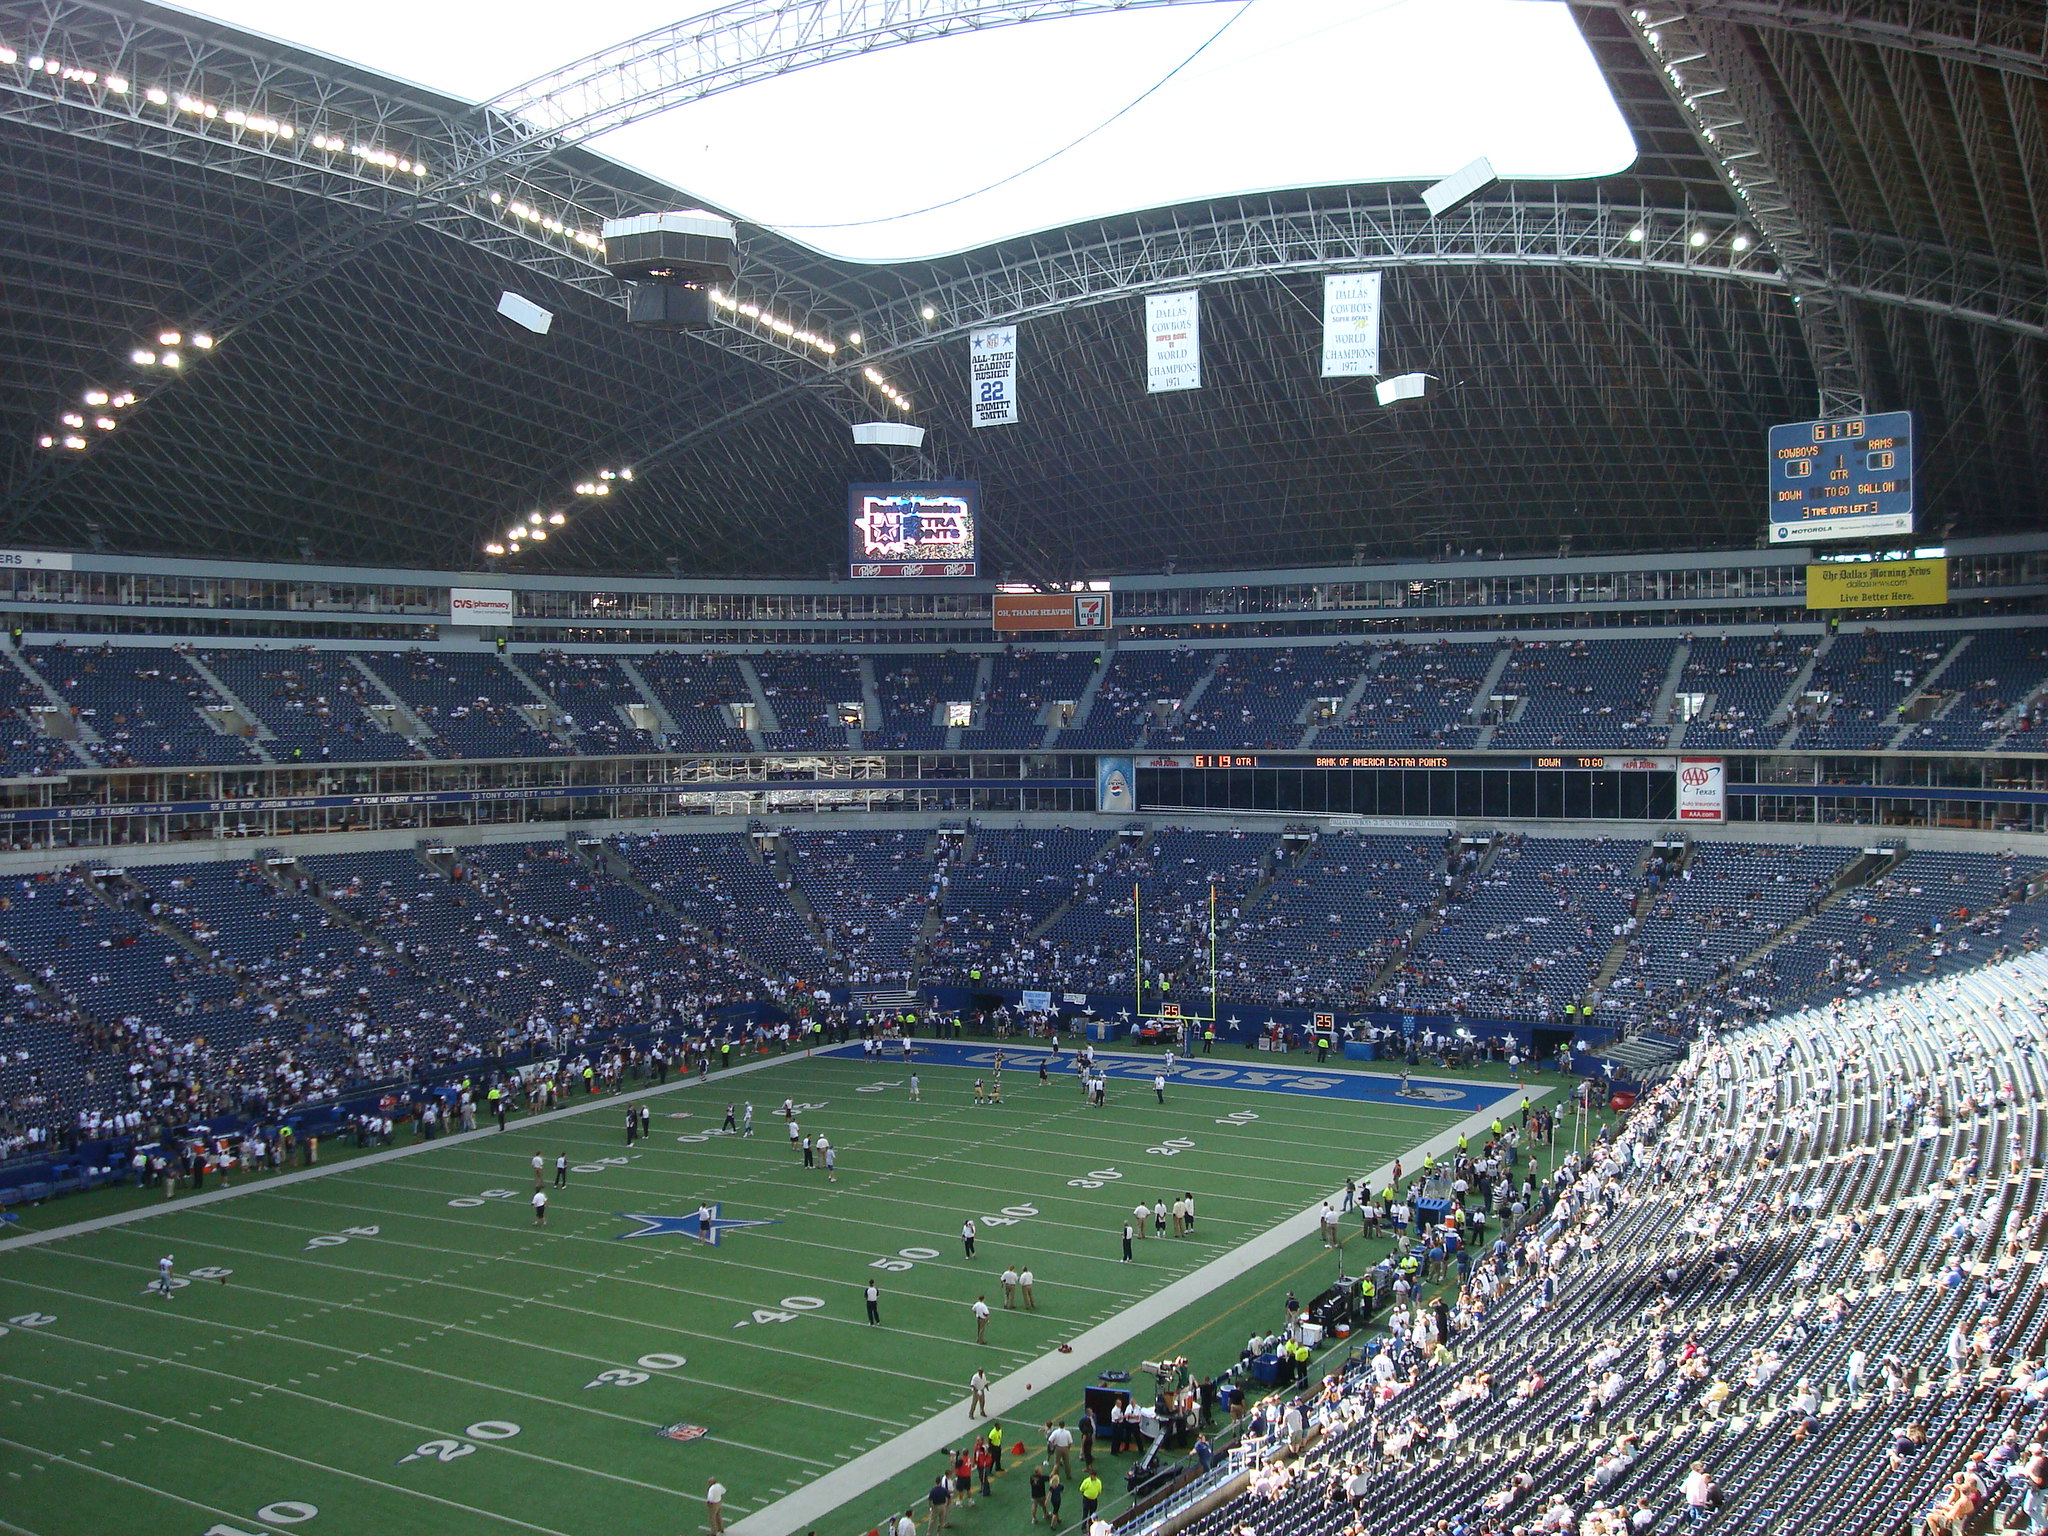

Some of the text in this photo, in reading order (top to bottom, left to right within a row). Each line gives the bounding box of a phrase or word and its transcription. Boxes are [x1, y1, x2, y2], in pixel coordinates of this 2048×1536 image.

[1335, 289, 1368, 300] DALLAS
[1156, 307, 1187, 319] DALLAS
[1330, 303, 1372, 314] COWBOYS
[1151, 320, 1192, 333] COWBOYS
[1335, 333, 1366, 344] WORLD
[972, 351, 1014, 364] ALL-TIME
[1157, 348, 1188, 361] WORLD
[1325, 348, 1376, 360] CHAMPIONS
[973, 360, 1011, 372] LEADING
[1149, 362, 1197, 377] CHAMPIONS
[1341, 361, 1358, 371] 1977
[975, 369, 1009, 380] RUSHER
[1165, 377, 1181, 387] 1971
[980, 380, 1004, 402] 22
[975, 400, 1011, 412] EMMITT
[980, 409, 1008, 421] SMITH
[1868, 438, 1893, 450] RAMS
[1778, 446, 1819, 459] COWBOYS
[1830, 469, 1849, 480] QTR
[1779, 490, 1802, 501] DOWN
[1824, 487, 1836, 497] TO
[1838, 486, 1850, 496] GO
[1858, 483, 1881, 494] BALL
[1802, 501, 1878, 519] 3 TIME OUTS LEFT 3
[903, 517, 957, 528] EXTRA
[903, 529, 960, 539] POINTS
[1791, 526, 1833, 535] MOTOROLA
[1822, 566, 1931, 581] The Dallas Morning News
[1840, 592, 1914, 603] Live Better Here.
[1012, 609, 1039, 617] THANK
[1235, 757, 1252, 766] QTR
[1316, 757, 1448, 767] BANK OF AMERICA EXTRA POINTS
[1538, 758, 1604, 767] DOWN TO GO
[1682, 767, 1708, 786] AAA
[623, 786, 659, 794] SCHRAMM
[1695, 788, 1716, 796] Texas
[223, 802, 237, 810] LEE
[240, 802, 256, 810] ROY
[259, 800, 288, 809] JORDAN
[380, 796, 410, 804] LANDRY
[70, 808, 97, 817] ROGER
[100, 806, 140, 816] STAUBACH
[1164, 1005, 1178, 1016] 25
[1316, 1015, 1332, 1028] 25
[965, 1052, 1345, 1091] COWBOYS
[1215, 1110, 1260, 1127] 10
[1145, 1138, 1196, 1156] 20
[1067, 1168, 1123, 1189] 30
[980, 1204, 1039, 1228] 40
[869, 1247, 941, 1271] 50
[752, 1296, 826, 1324] 40
[597, 1353, 688, 1388] 30
[416, 1420, 523, 1463] 20
